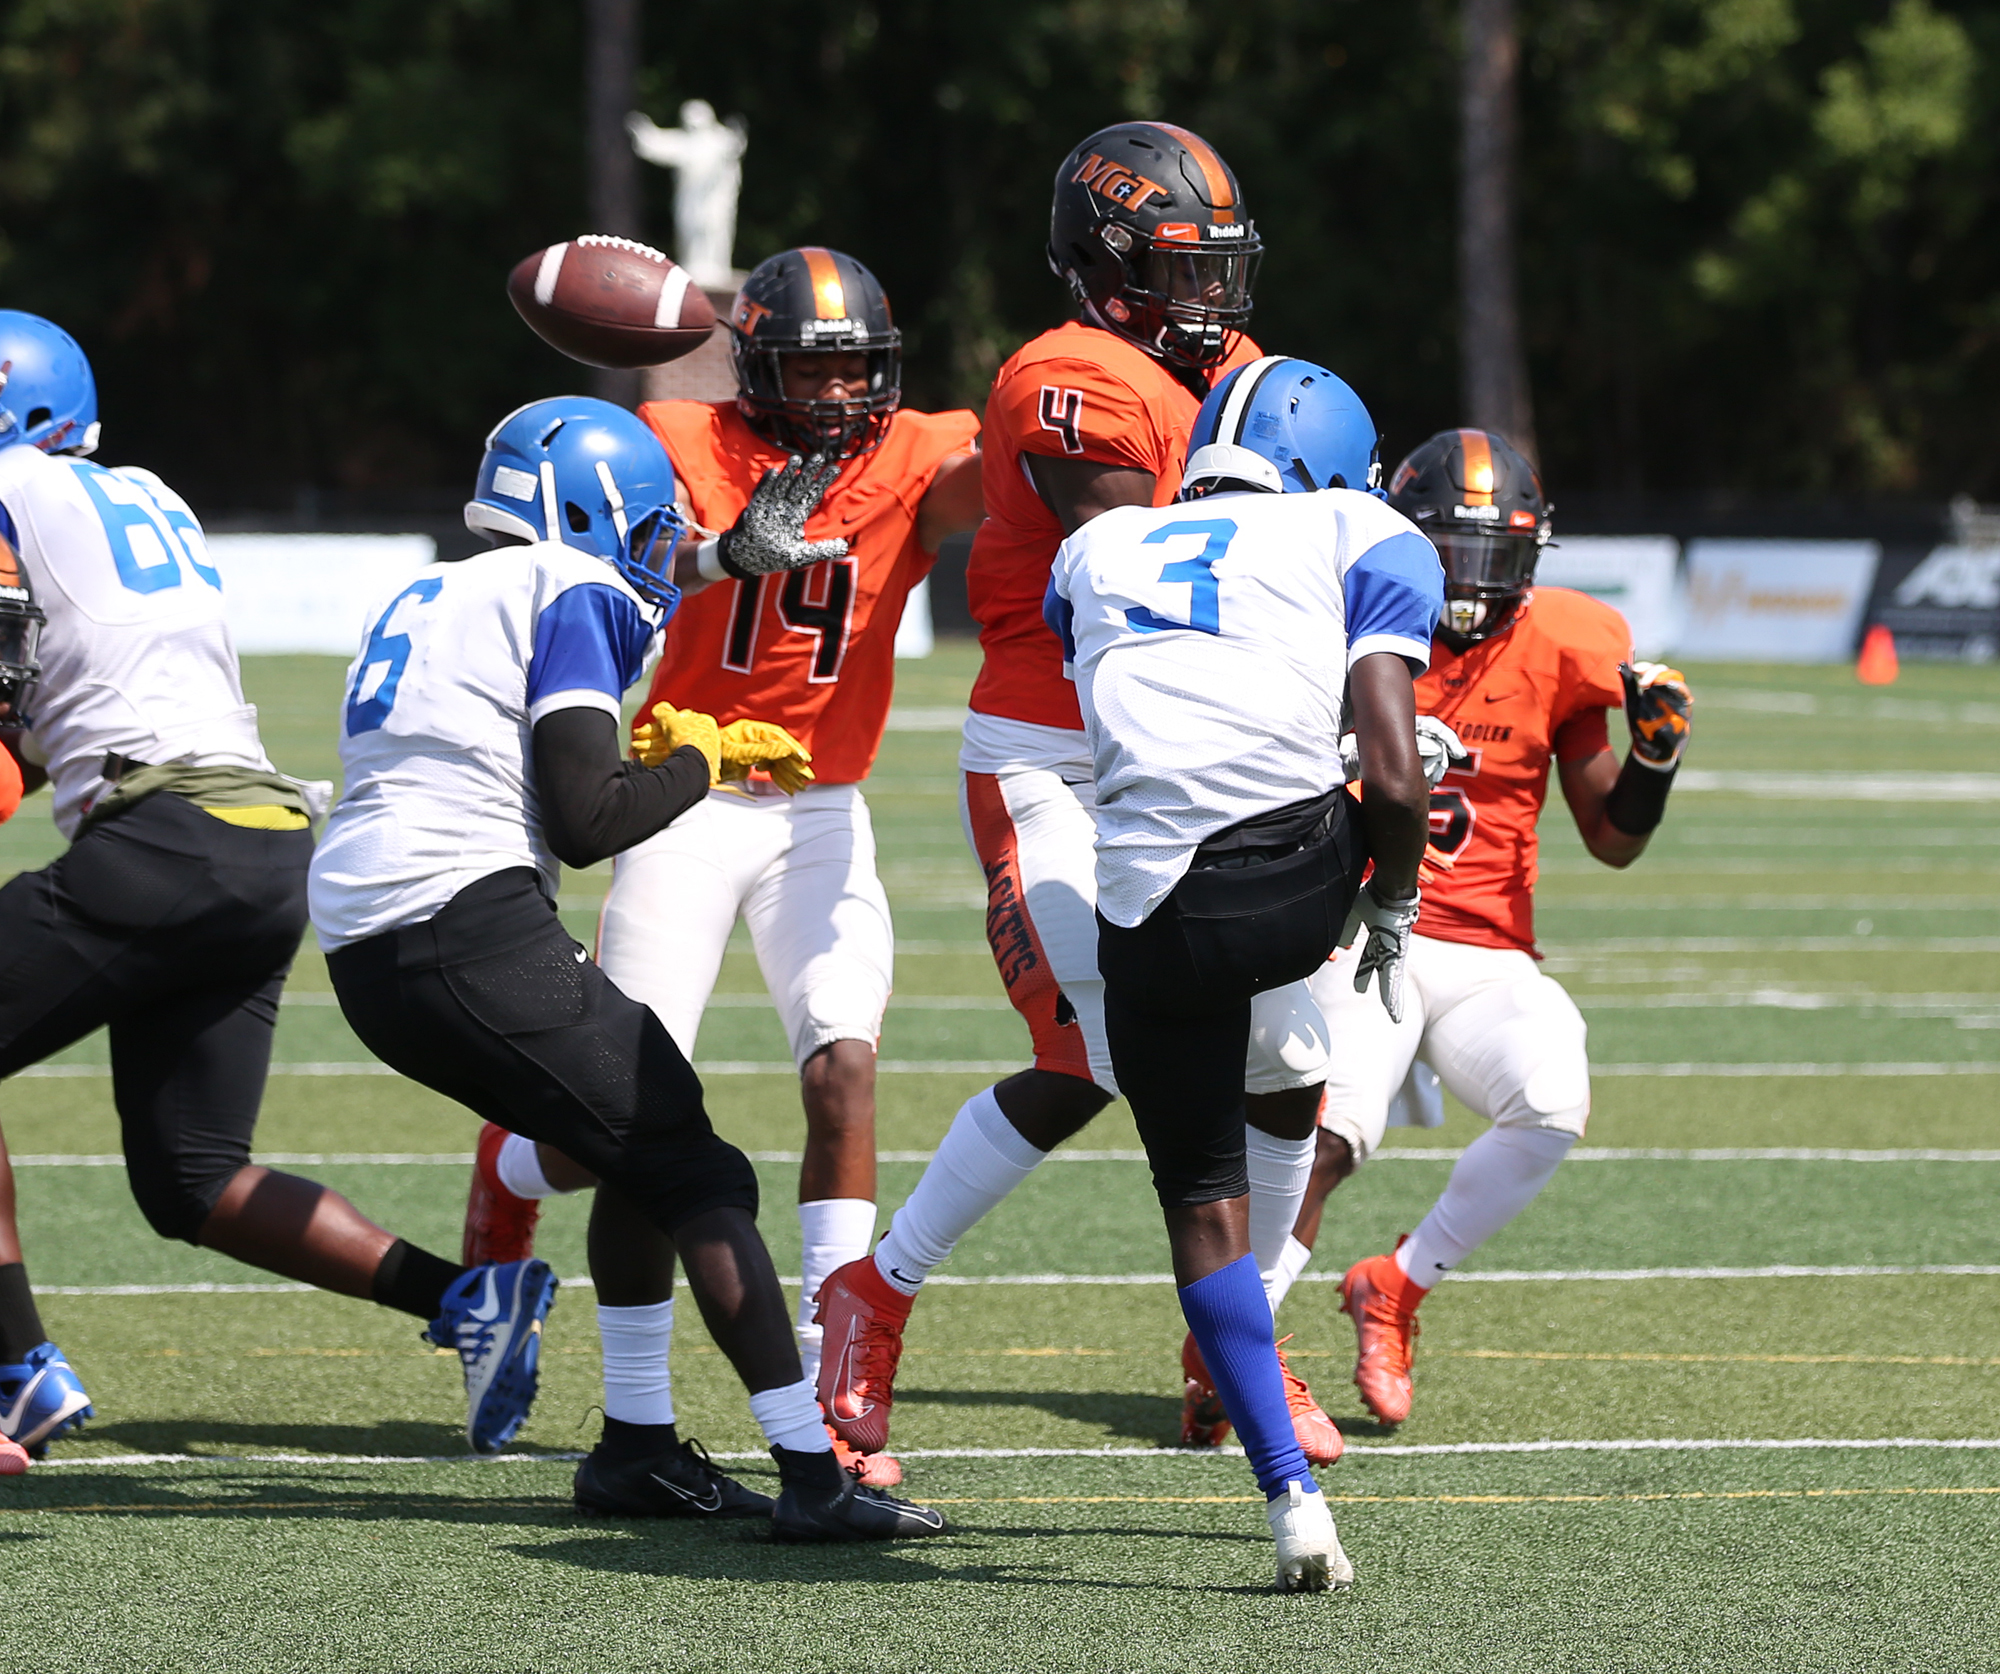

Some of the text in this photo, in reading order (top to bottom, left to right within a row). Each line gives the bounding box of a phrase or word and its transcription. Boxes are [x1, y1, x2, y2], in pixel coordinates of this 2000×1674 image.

[1209, 224, 1244, 239] Riddell
[1037, 384, 1085, 455] 4
[68, 463, 223, 596] 66
[1125, 518, 1239, 636] 3
[346, 575, 443, 739] 6
[721, 556, 859, 684] 14
